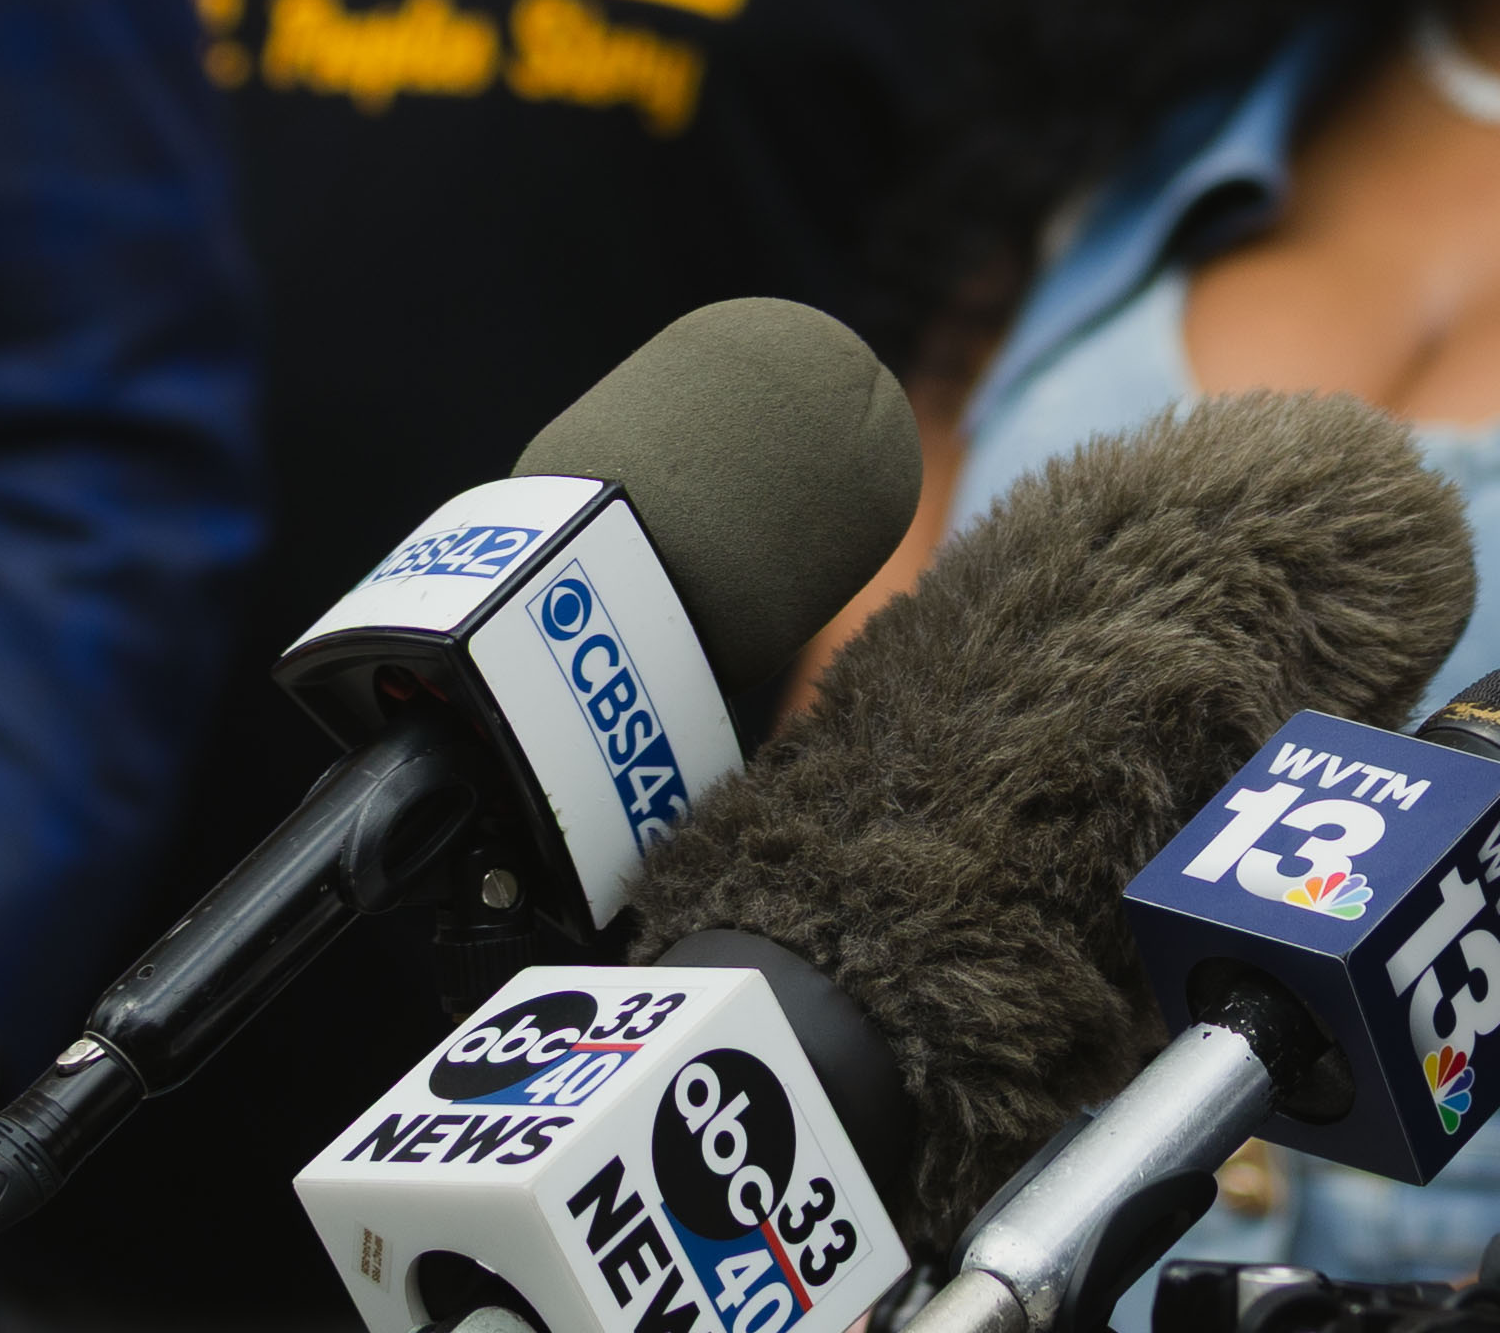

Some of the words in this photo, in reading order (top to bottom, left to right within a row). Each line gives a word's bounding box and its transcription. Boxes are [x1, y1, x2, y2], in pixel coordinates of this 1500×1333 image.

[1267, 741, 1431, 811] WVTM
[1181, 782, 1386, 903] 13
[446, 1015, 581, 1064] abc
[590, 992, 687, 1040] 33
[524, 1053, 622, 1105] 40
[341, 1113, 575, 1165] NEWS
[675, 1062, 775, 1226] abc
[778, 1177, 857, 1286] 33
[715, 1248, 794, 1333] 40
